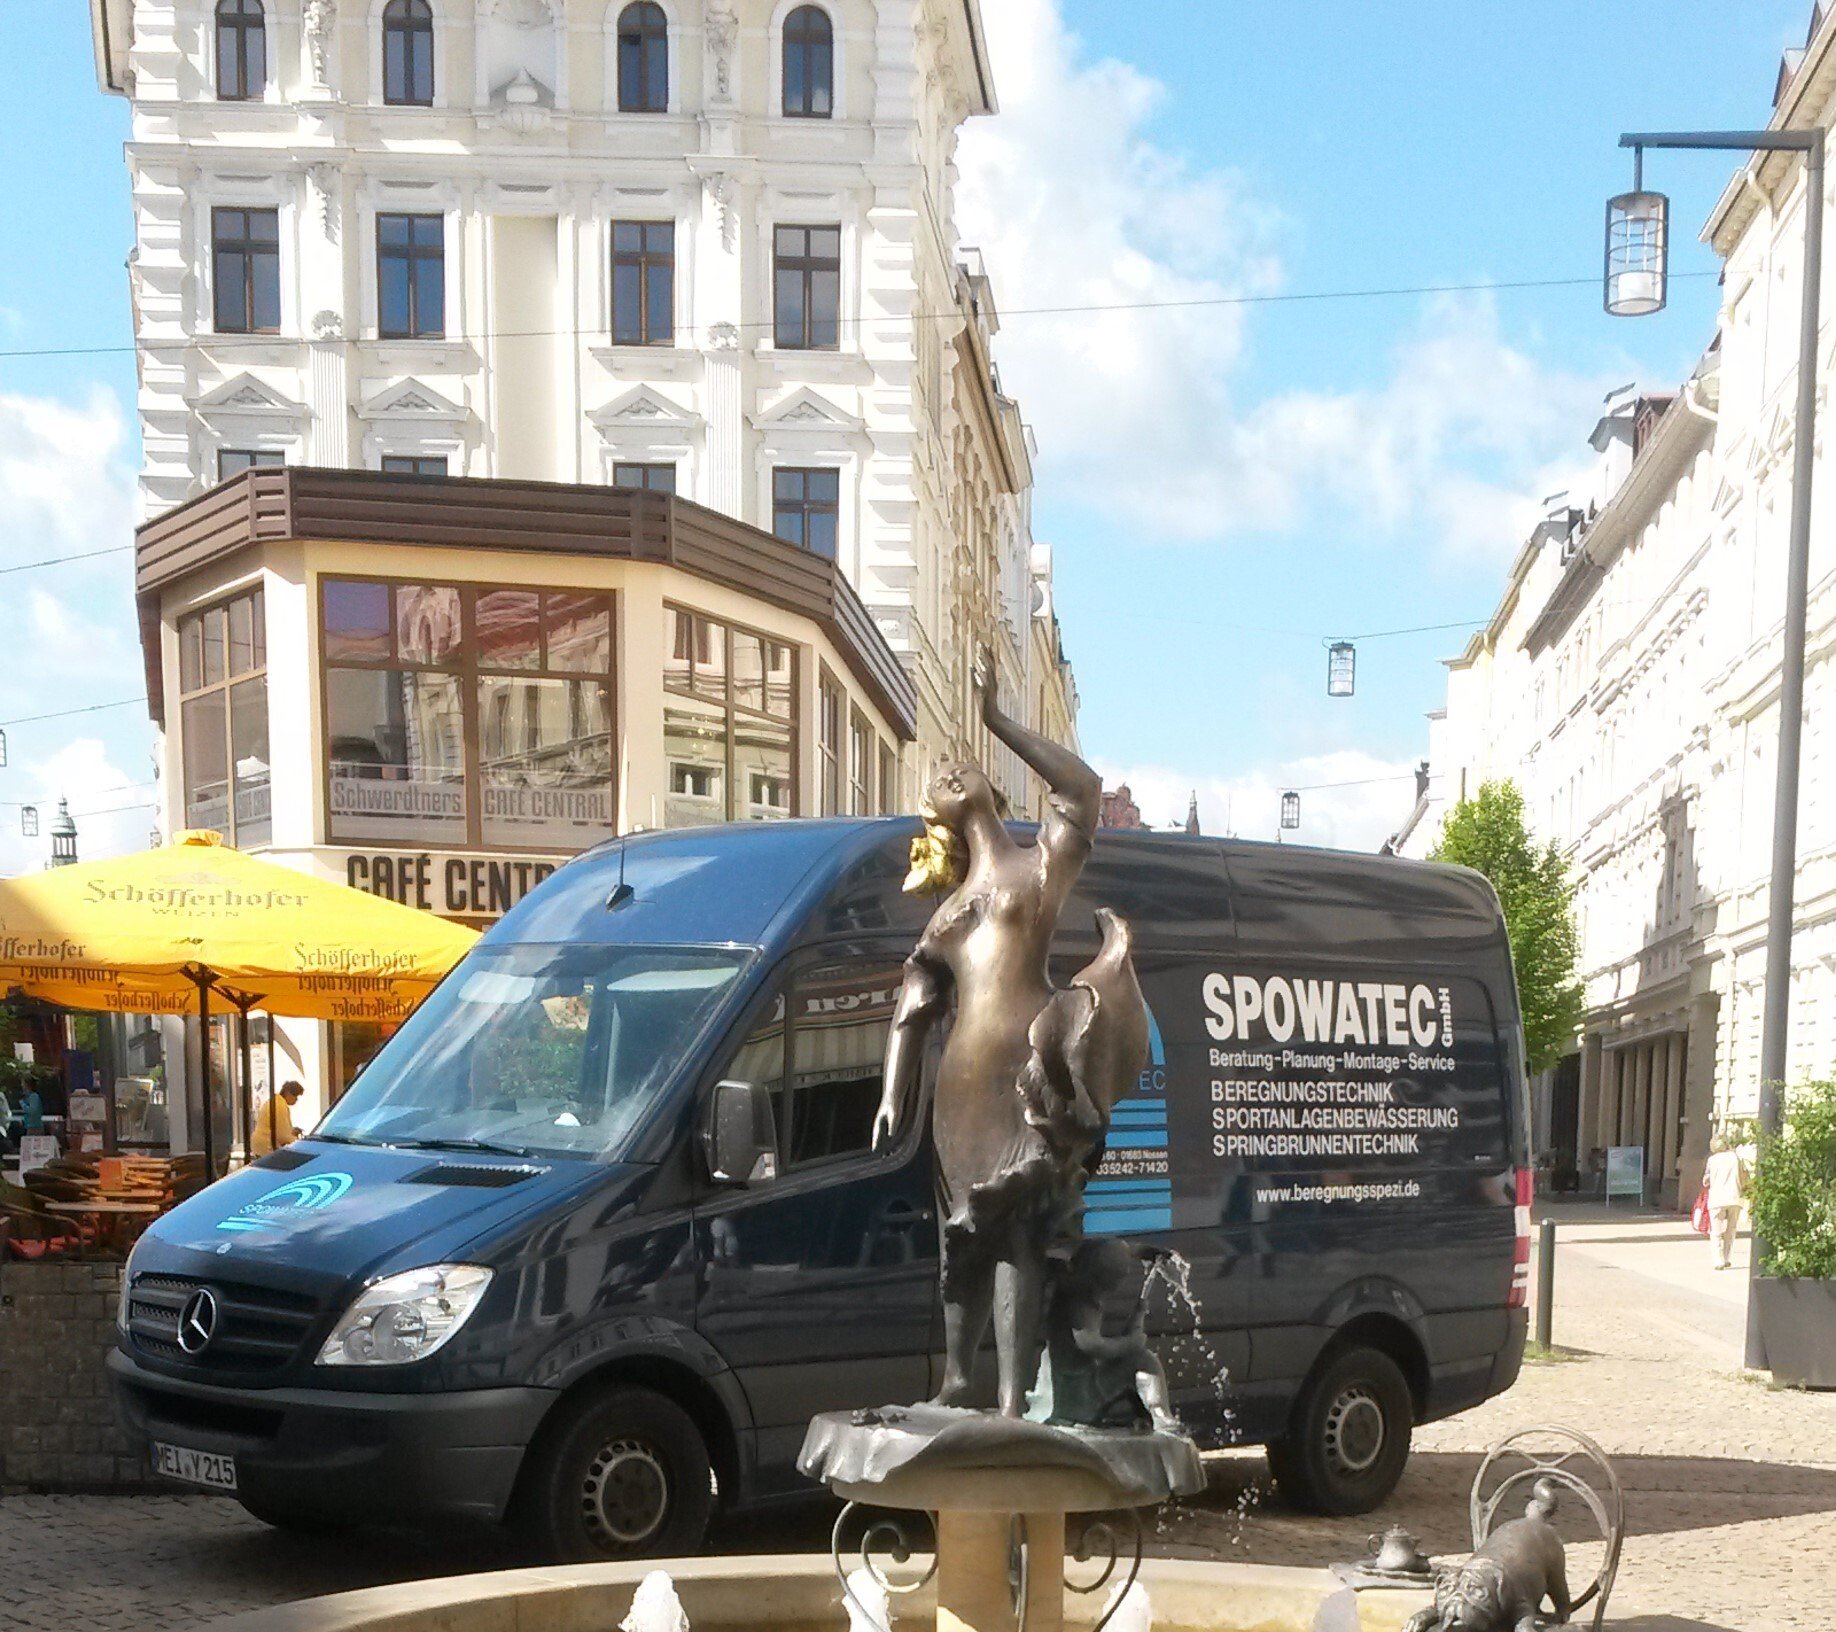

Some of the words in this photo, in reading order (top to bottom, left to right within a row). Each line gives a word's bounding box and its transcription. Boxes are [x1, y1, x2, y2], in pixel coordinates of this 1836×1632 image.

[334, 782, 461, 813] Schwerdtners
[484, 788, 527, 816] CAFÉ
[531, 790, 609, 819] CENTRAL
[83, 879, 309, 910] Schöfferhofer
[347, 853, 432, 910] CAFÉ
[295, 942, 418, 972] Schöfferhofer
[1202, 973, 1437, 1048] SPOWATEC
[1438, 987, 1454, 1048] GmbH
[1211, 1080, 1394, 1103] BEREGNUNGSTECHNIK
[1212, 1102, 1459, 1130] SPORTANLAGENBEWÄSSERUNG
[1213, 1133, 1419, 1157] SPRINGBRUNNENTECHNIK
[1256, 1179, 1420, 1204] www.beregnungsspezi.de
[203, 1456, 233, 1484] 215
